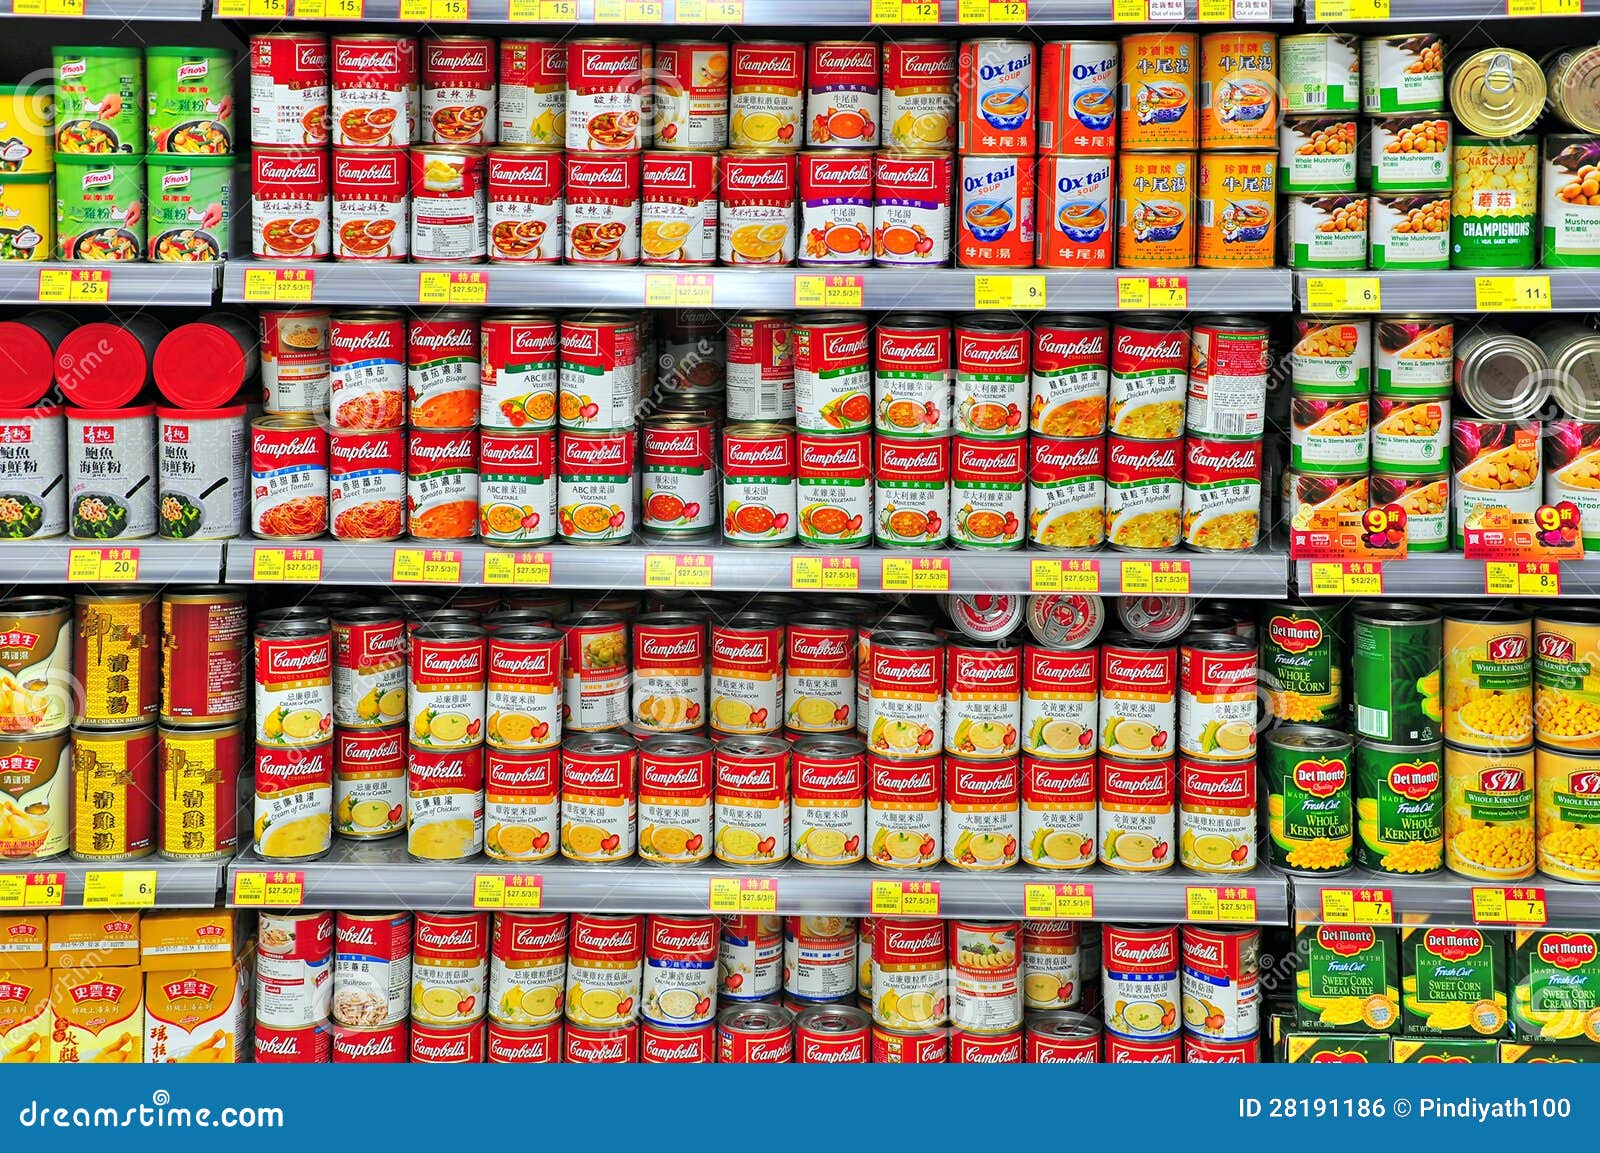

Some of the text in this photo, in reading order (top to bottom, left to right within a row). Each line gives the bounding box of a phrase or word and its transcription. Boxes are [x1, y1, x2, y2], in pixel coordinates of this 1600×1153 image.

[62, 66, 85, 76] Knorr
[180, 65, 207, 77] Knorr
[980, 54, 1031, 81] Ox tail
[1137, 58, 1189, 74] 牛尾湯
[1219, 57, 1272, 73] 牛尾湯
[1000, 71, 1021, 84] SOUP
[1073, 64, 1097, 81] Ox
[1092, 71, 1112, 84] SOUP
[86, 175, 114, 185] Knorr
[164, 175, 189, 185] Knorr
[964, 165, 1015, 193] Ox tail
[1058, 166, 1109, 193] Ox tail
[1133, 176, 1185, 192] 牛尾湯
[1222, 176, 1272, 192] 牛尾湯
[978, 182, 1001, 195] SOUP
[1477, 193, 1512, 207] 蘑菇
[1463, 222, 1530, 237] CHAMPIGNONS
[421, 374, 467, 393] Tomato Bisque
[1126, 390, 1149, 400] Chicken
[80, 461, 121, 474] 海鮮粉
[269, 481, 314, 497] Sweet Tomato
[1122, 500, 1144, 509] Chicken
[1272, 624, 1319, 639] Del Monte
[1274, 655, 1312, 668] Fresh Cut
[1278, 668, 1311, 682] WHOLE
[1300, 681, 1326, 696] CORN
[1298, 769, 1346, 781] Del Monte
[1392, 772, 1438, 785] Del Monte
[1398, 803, 1435, 815] Fresh Cut
[1306, 814, 1338, 827] WHOLE
[1402, 818, 1434, 831] WHOLE
[1290, 824, 1324, 837] KERNEL
[1385, 827, 1421, 841] KERNEL
[1322, 930, 1371, 942] Del Monte
[1428, 935, 1480, 948] Del Monte
[1435, 966, 1475, 978] Fresh Cut
[1322, 976, 1374, 987] SWEET CORN
[1429, 980, 1481, 992] SWEET CORN
[74, 983, 118, 999] 史雲生
[168, 981, 210, 996] 史雲生
[1322, 985, 1374, 996] CREAM STYLE
[1542, 989, 1596, 1000] SWEET CORN
[1429, 990, 1481, 1001] CREAM STYLE
